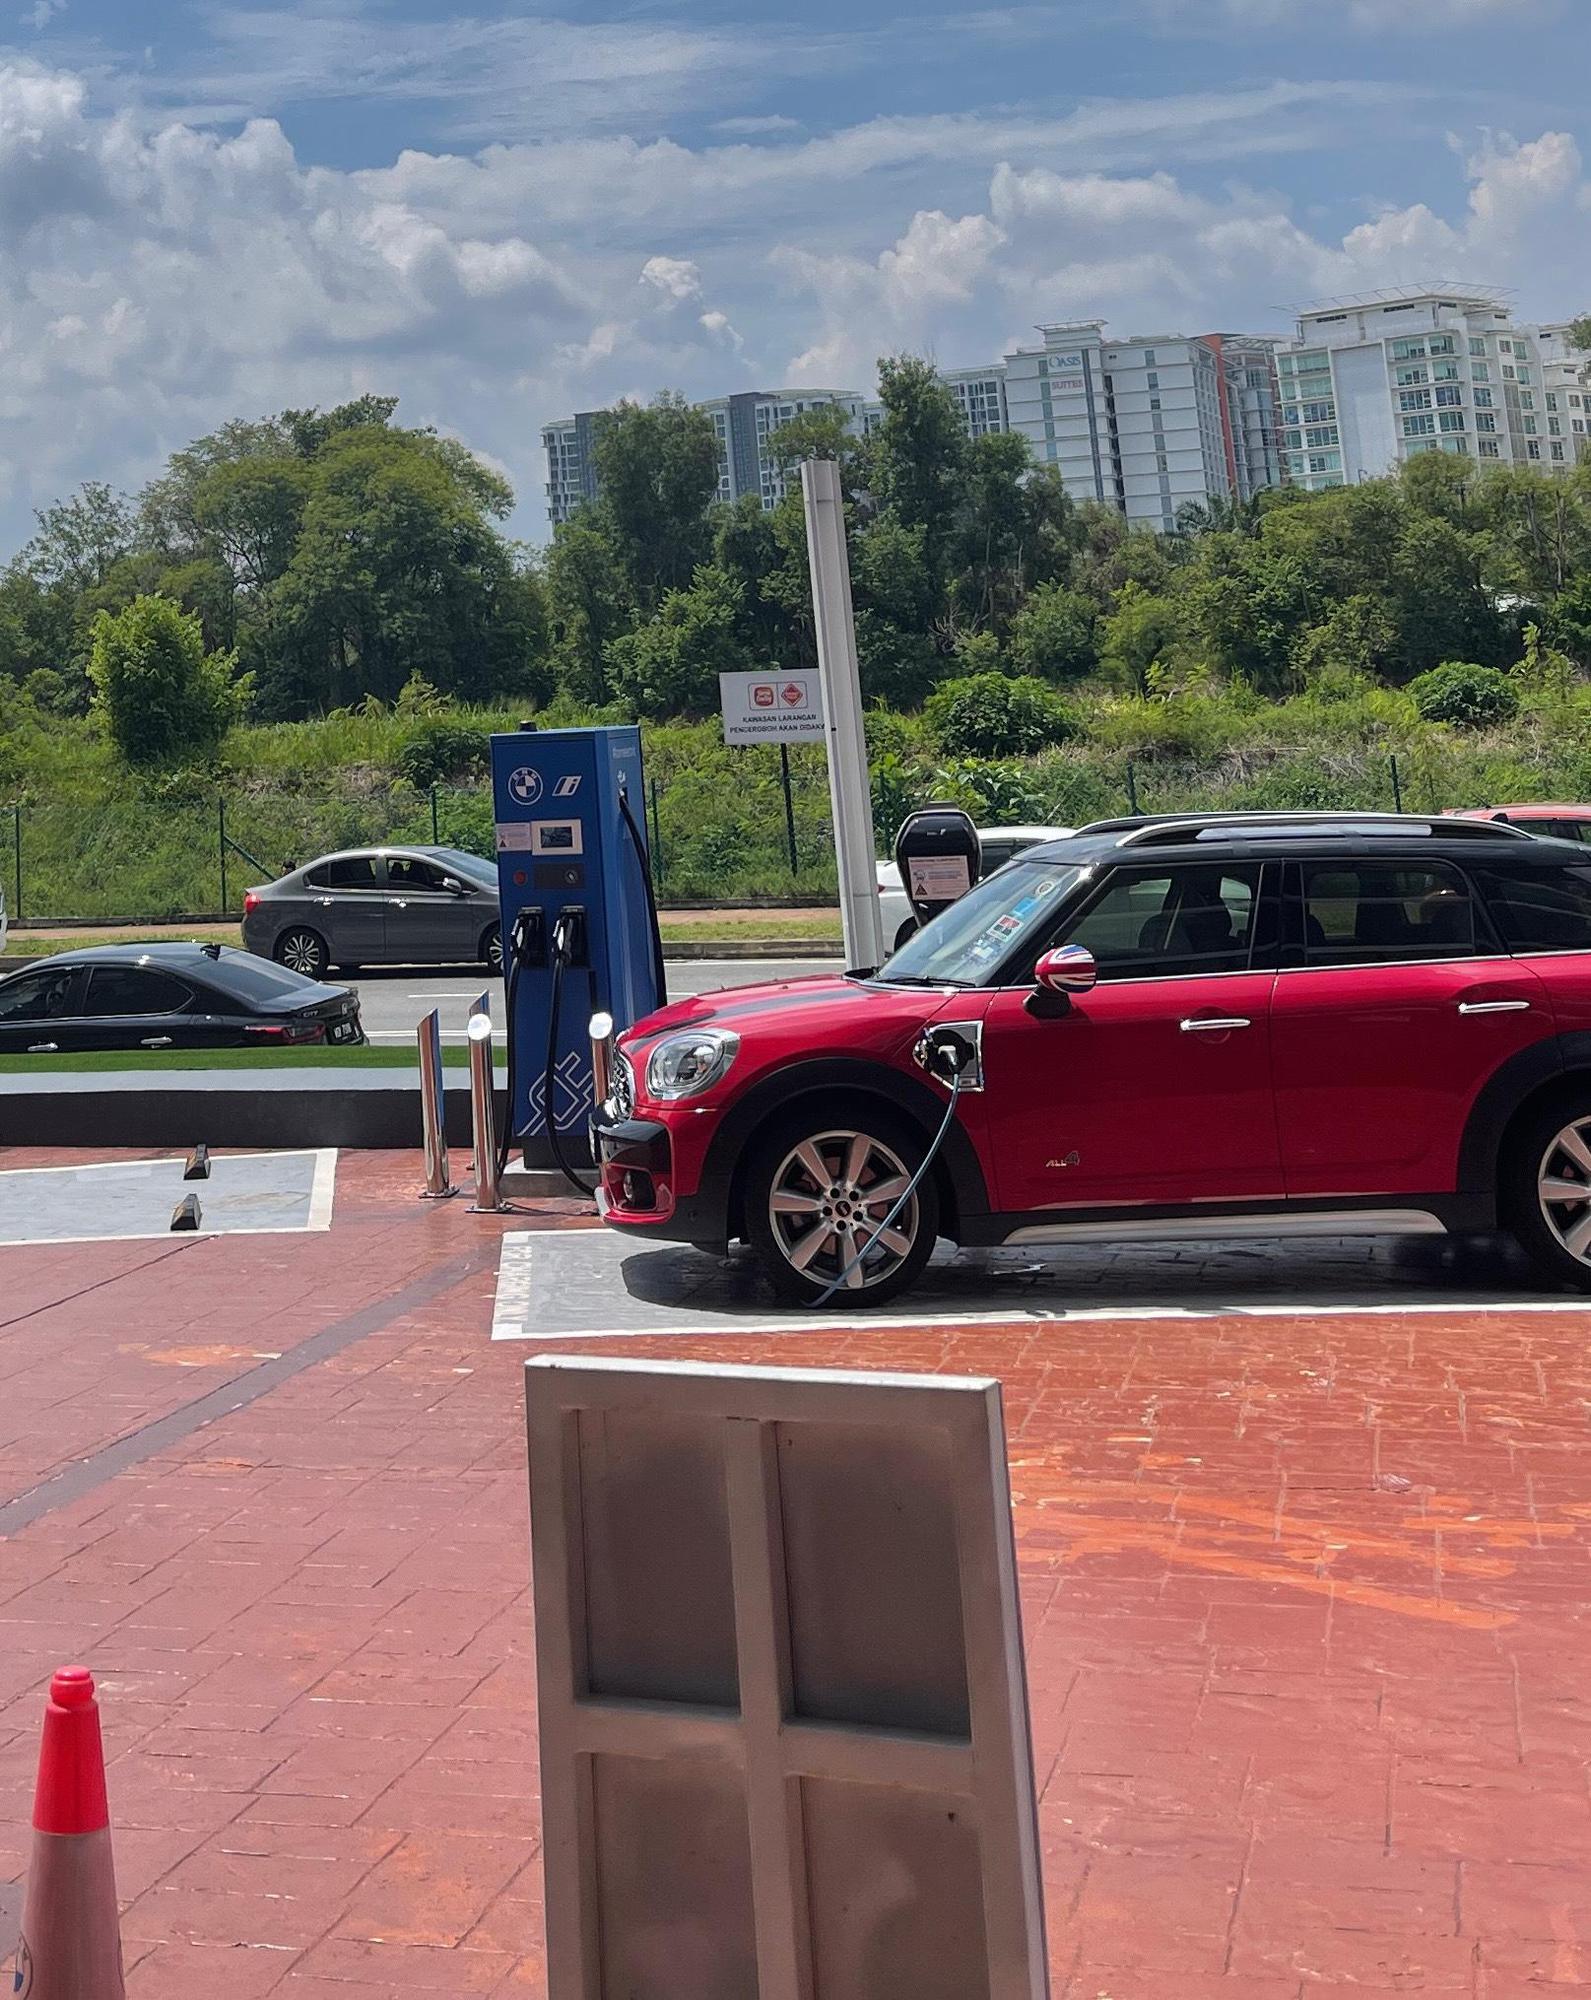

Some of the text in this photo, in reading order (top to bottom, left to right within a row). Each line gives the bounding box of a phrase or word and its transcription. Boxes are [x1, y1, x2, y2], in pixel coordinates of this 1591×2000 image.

[1048, 355, 1082, 368] OASIS
[1052, 379, 1084, 391] SUITES
[778, 714, 817, 722] LARANGAN
[779, 724, 798, 732] AKAN
